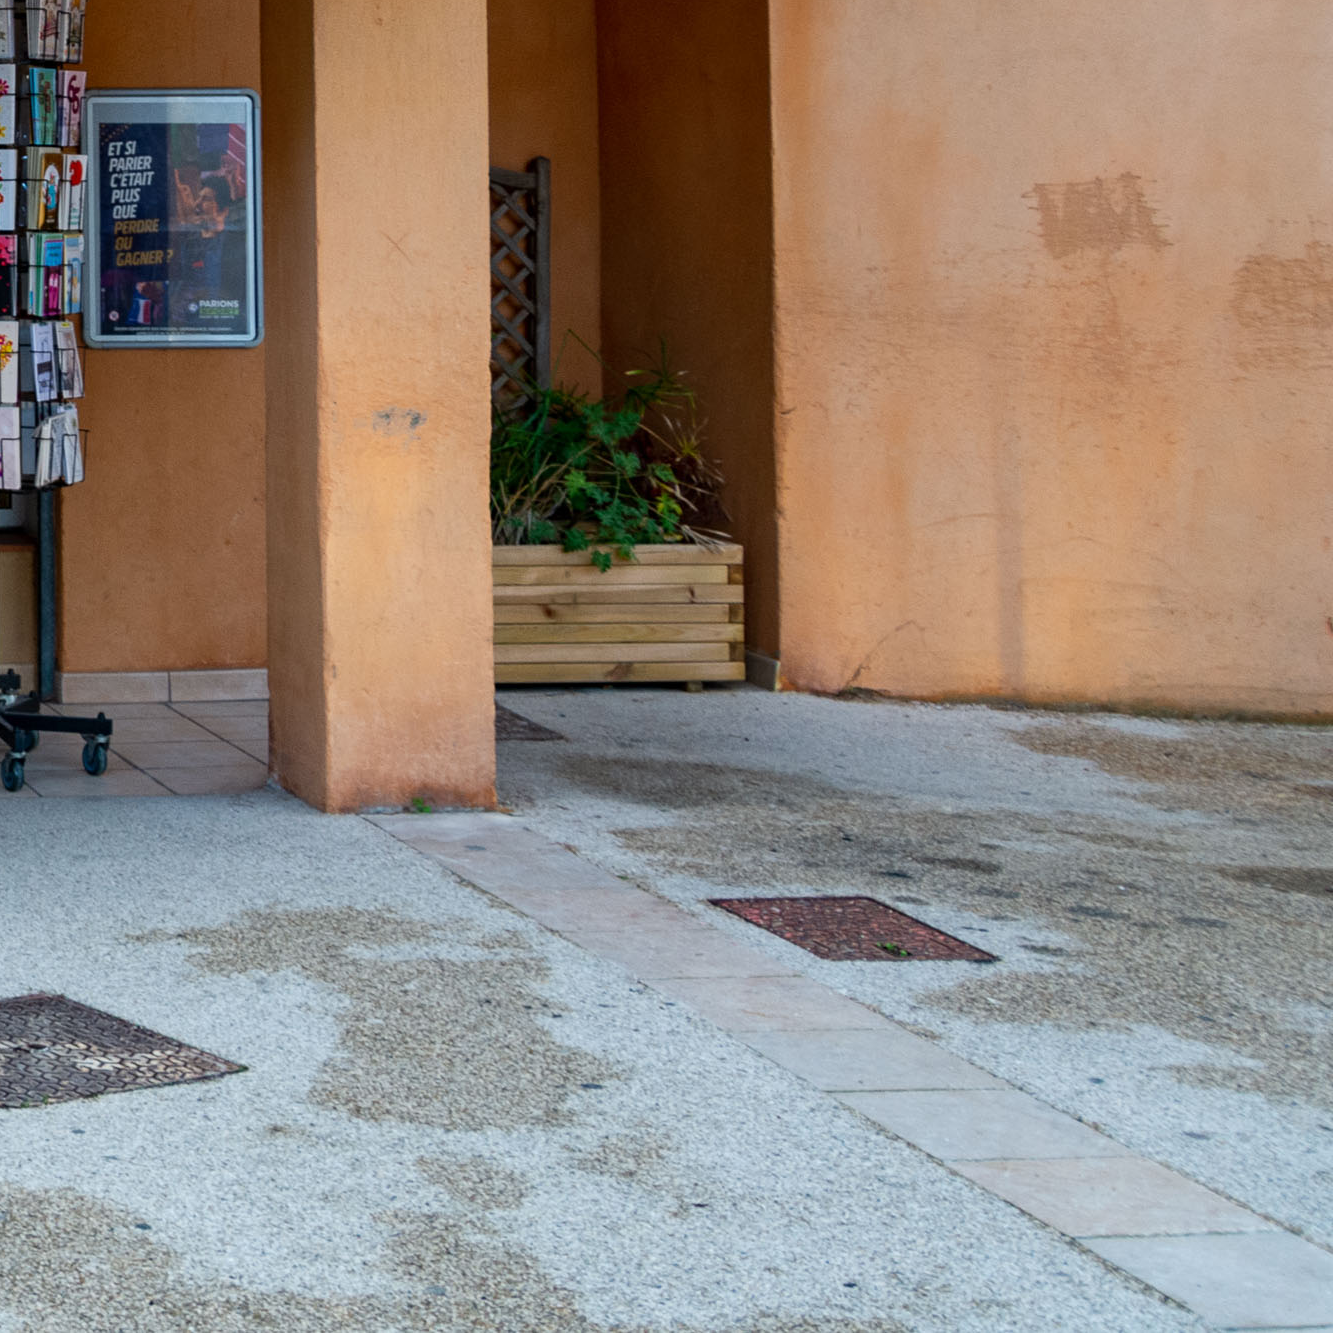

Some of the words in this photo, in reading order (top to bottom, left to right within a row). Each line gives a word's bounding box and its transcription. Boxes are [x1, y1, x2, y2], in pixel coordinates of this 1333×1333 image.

[107, 141, 123, 157] ET
[124, 140, 137, 156] SI
[108, 156, 152, 172] PARIER
[111, 188, 141, 204] PLUS
[112, 204, 138, 219] QUE
[113, 219, 160, 235] PERDRE
[115, 236, 134, 251] OU
[116, 250, 163, 267] GAGNER
[198, 299, 240, 308] PARIONS
